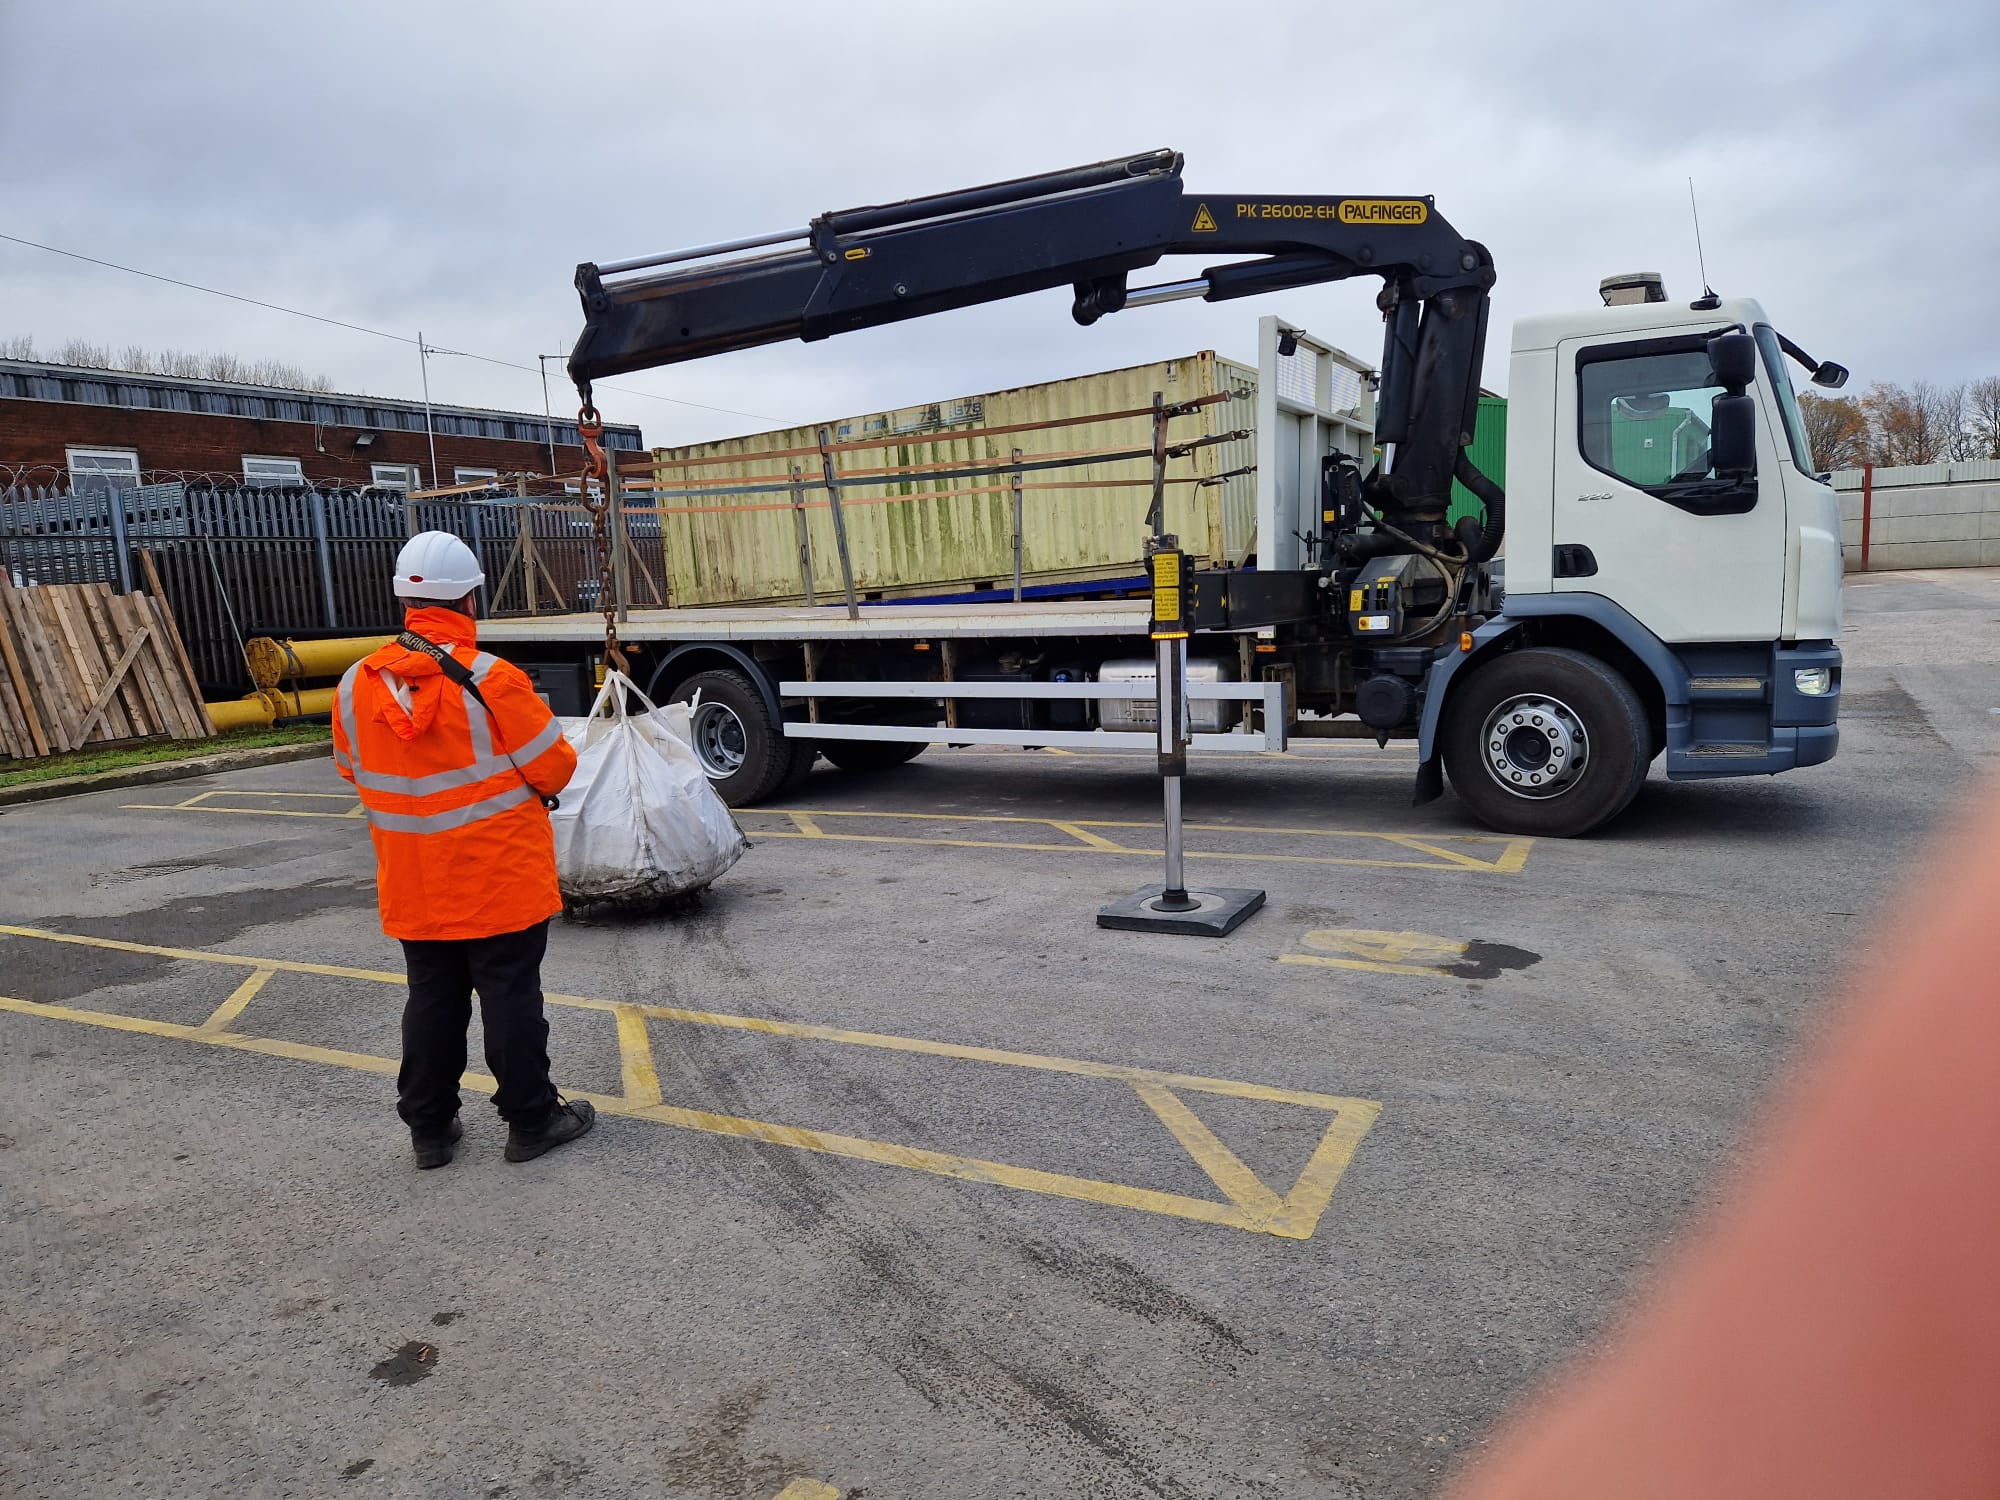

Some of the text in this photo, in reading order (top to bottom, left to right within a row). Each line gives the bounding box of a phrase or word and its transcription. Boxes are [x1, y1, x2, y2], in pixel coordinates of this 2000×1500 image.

[1236, 203, 1257, 218] PK
[1344, 204, 1422, 220] PALFINGER
[1577, 492, 1614, 502] 220
[399, 632, 444, 662] PALFINGER
